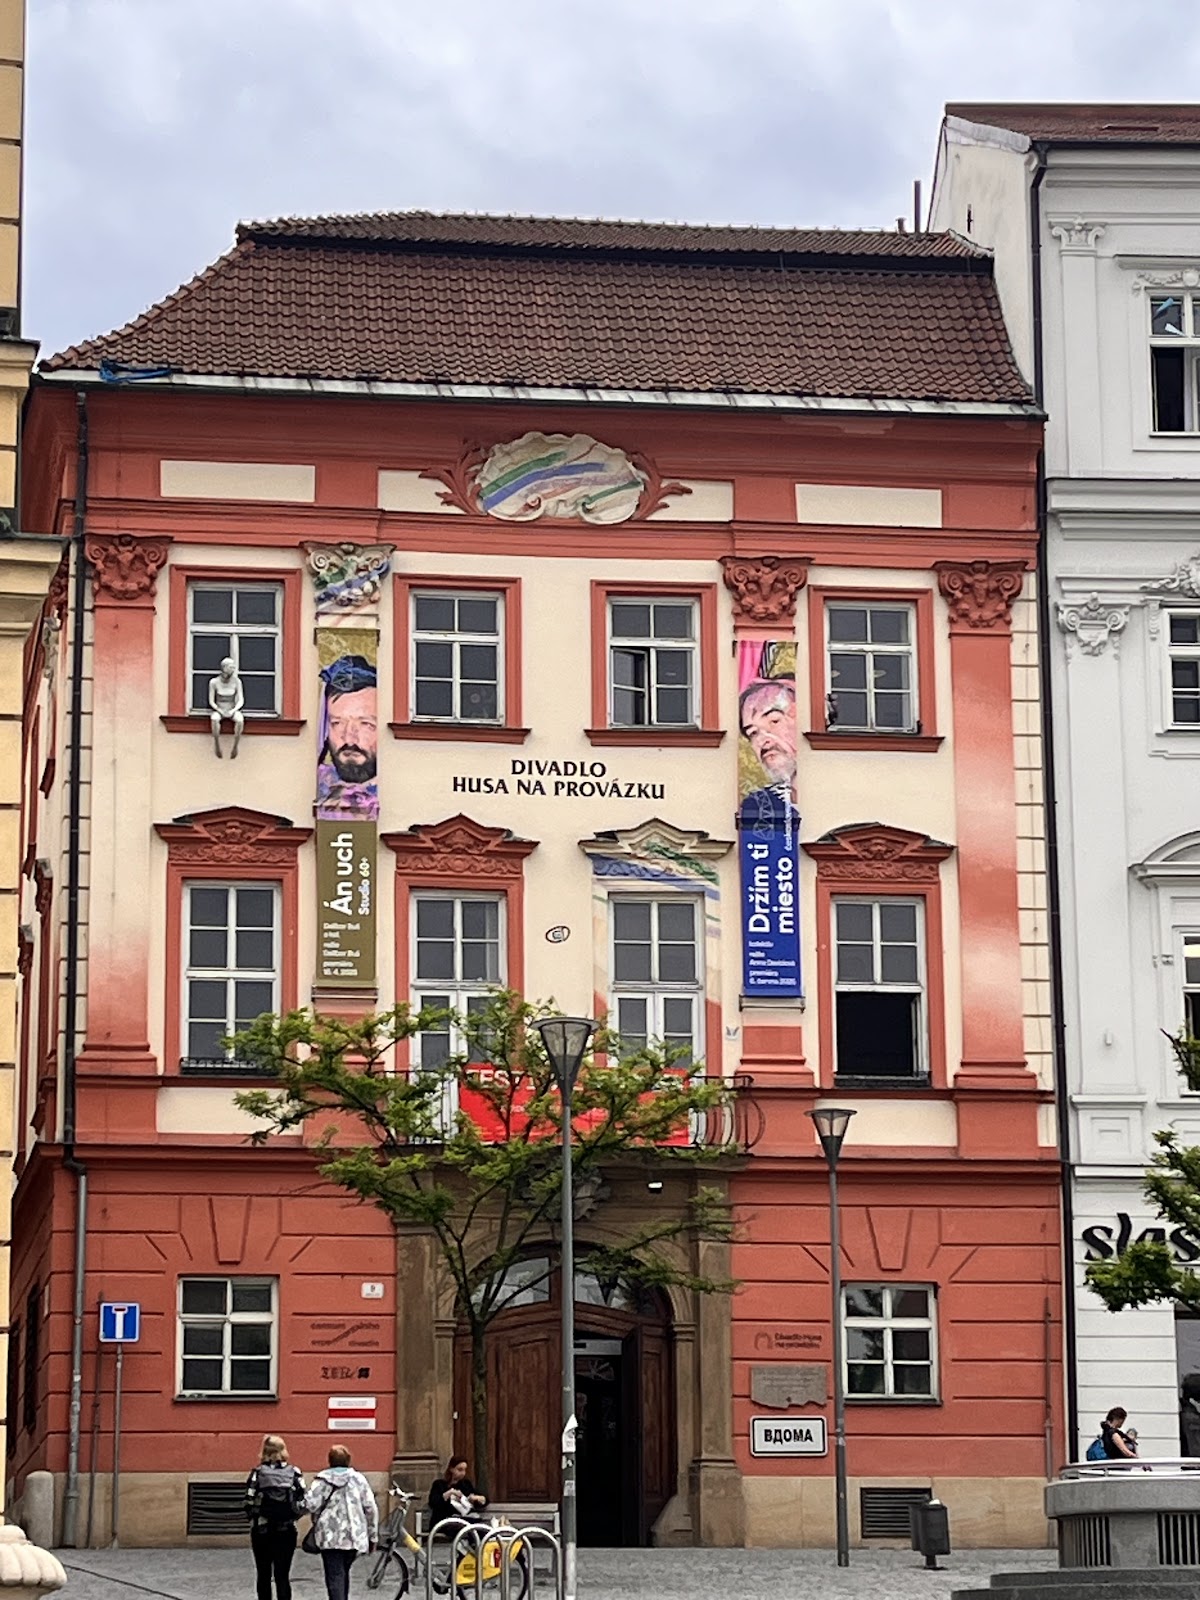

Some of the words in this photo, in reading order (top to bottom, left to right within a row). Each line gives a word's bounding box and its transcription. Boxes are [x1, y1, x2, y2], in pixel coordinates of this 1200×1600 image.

[511, 759, 607, 778] DIVADLO
[453, 776, 509, 794] HUSA
[517, 779, 546, 796] NA
[554, 778, 665, 800] PROVÁZKU
[329, 832, 353, 876] uch
[747, 844, 769, 860] ti
[323, 881, 353, 916] Án
[358, 879, 370, 916] Studio
[748, 865, 771, 933] Držím
[772, 856, 795, 934] miesto
[764, 1428, 814, 1445] ВДОМА
